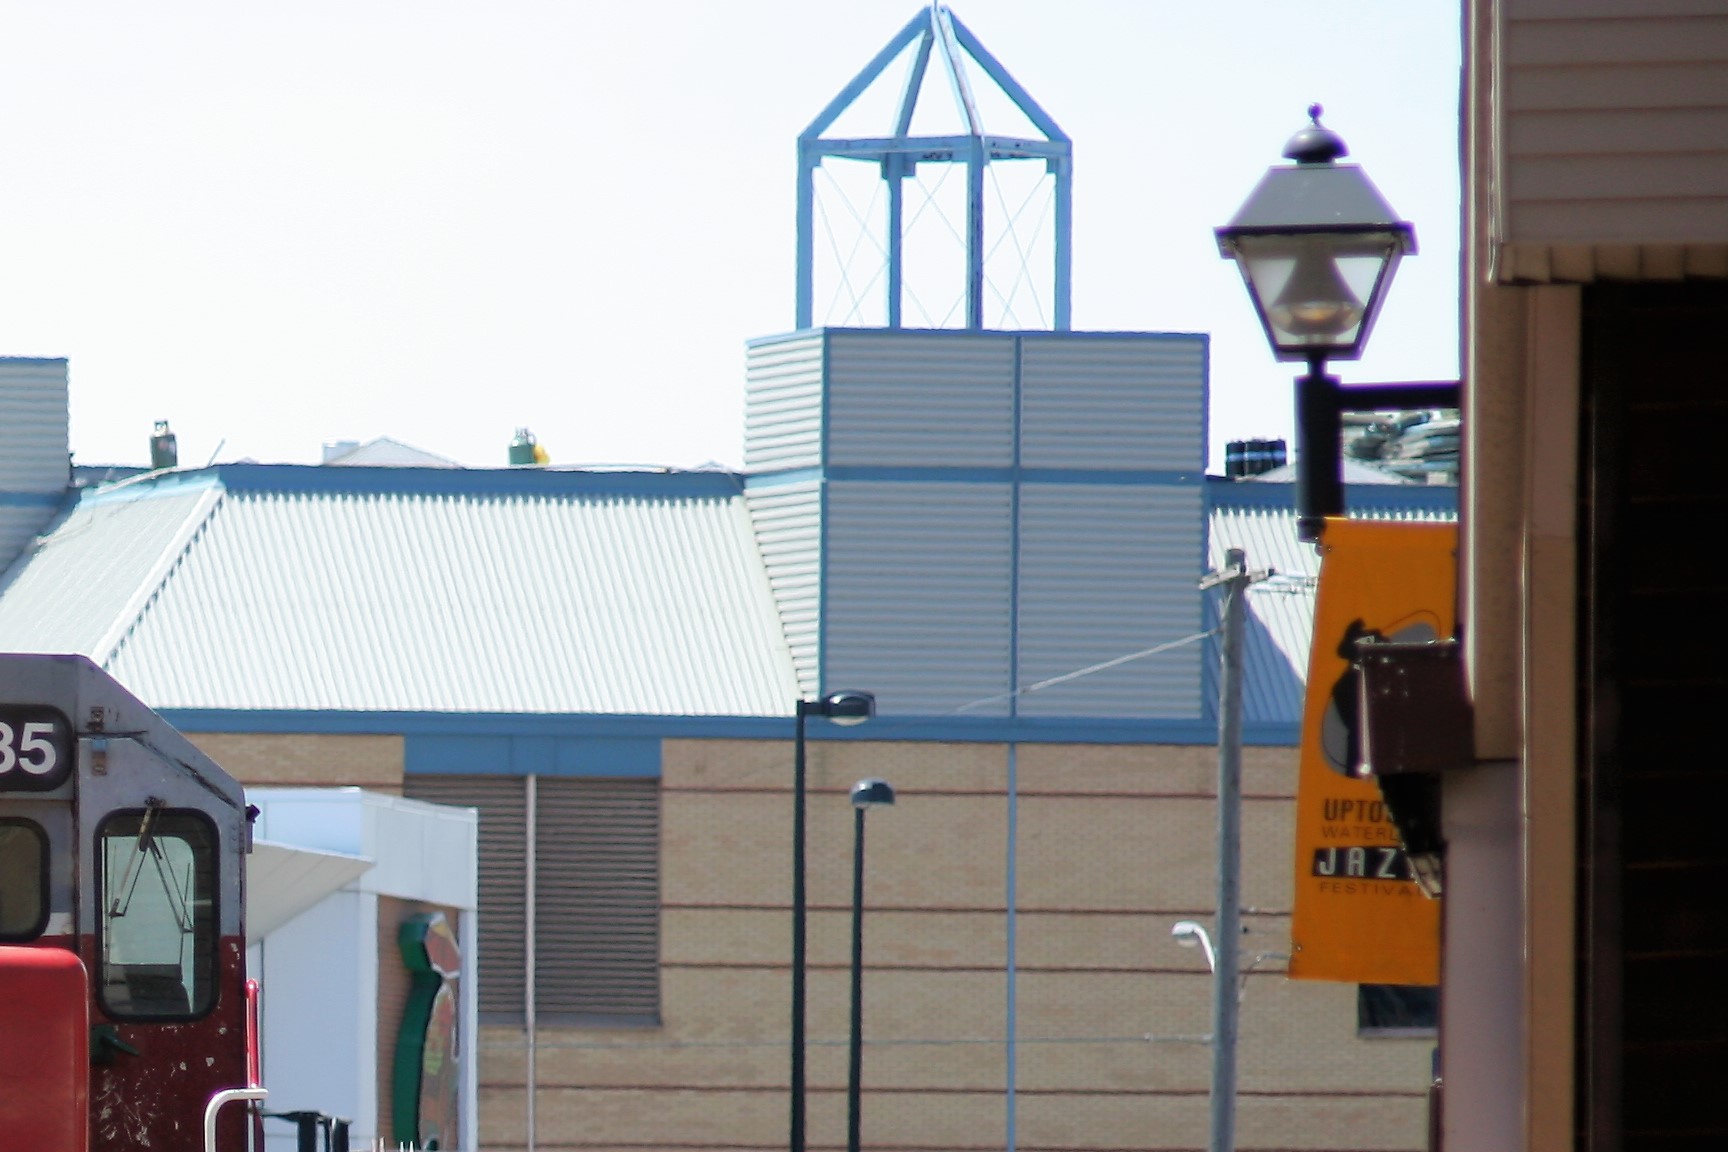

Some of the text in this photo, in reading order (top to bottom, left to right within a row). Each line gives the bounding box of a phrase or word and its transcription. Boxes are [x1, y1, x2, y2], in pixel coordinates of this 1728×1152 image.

[1323, 798, 1393, 823] UPTO
[1321, 826, 1398, 841] WATERL
[1319, 847, 1397, 878] JAZ
